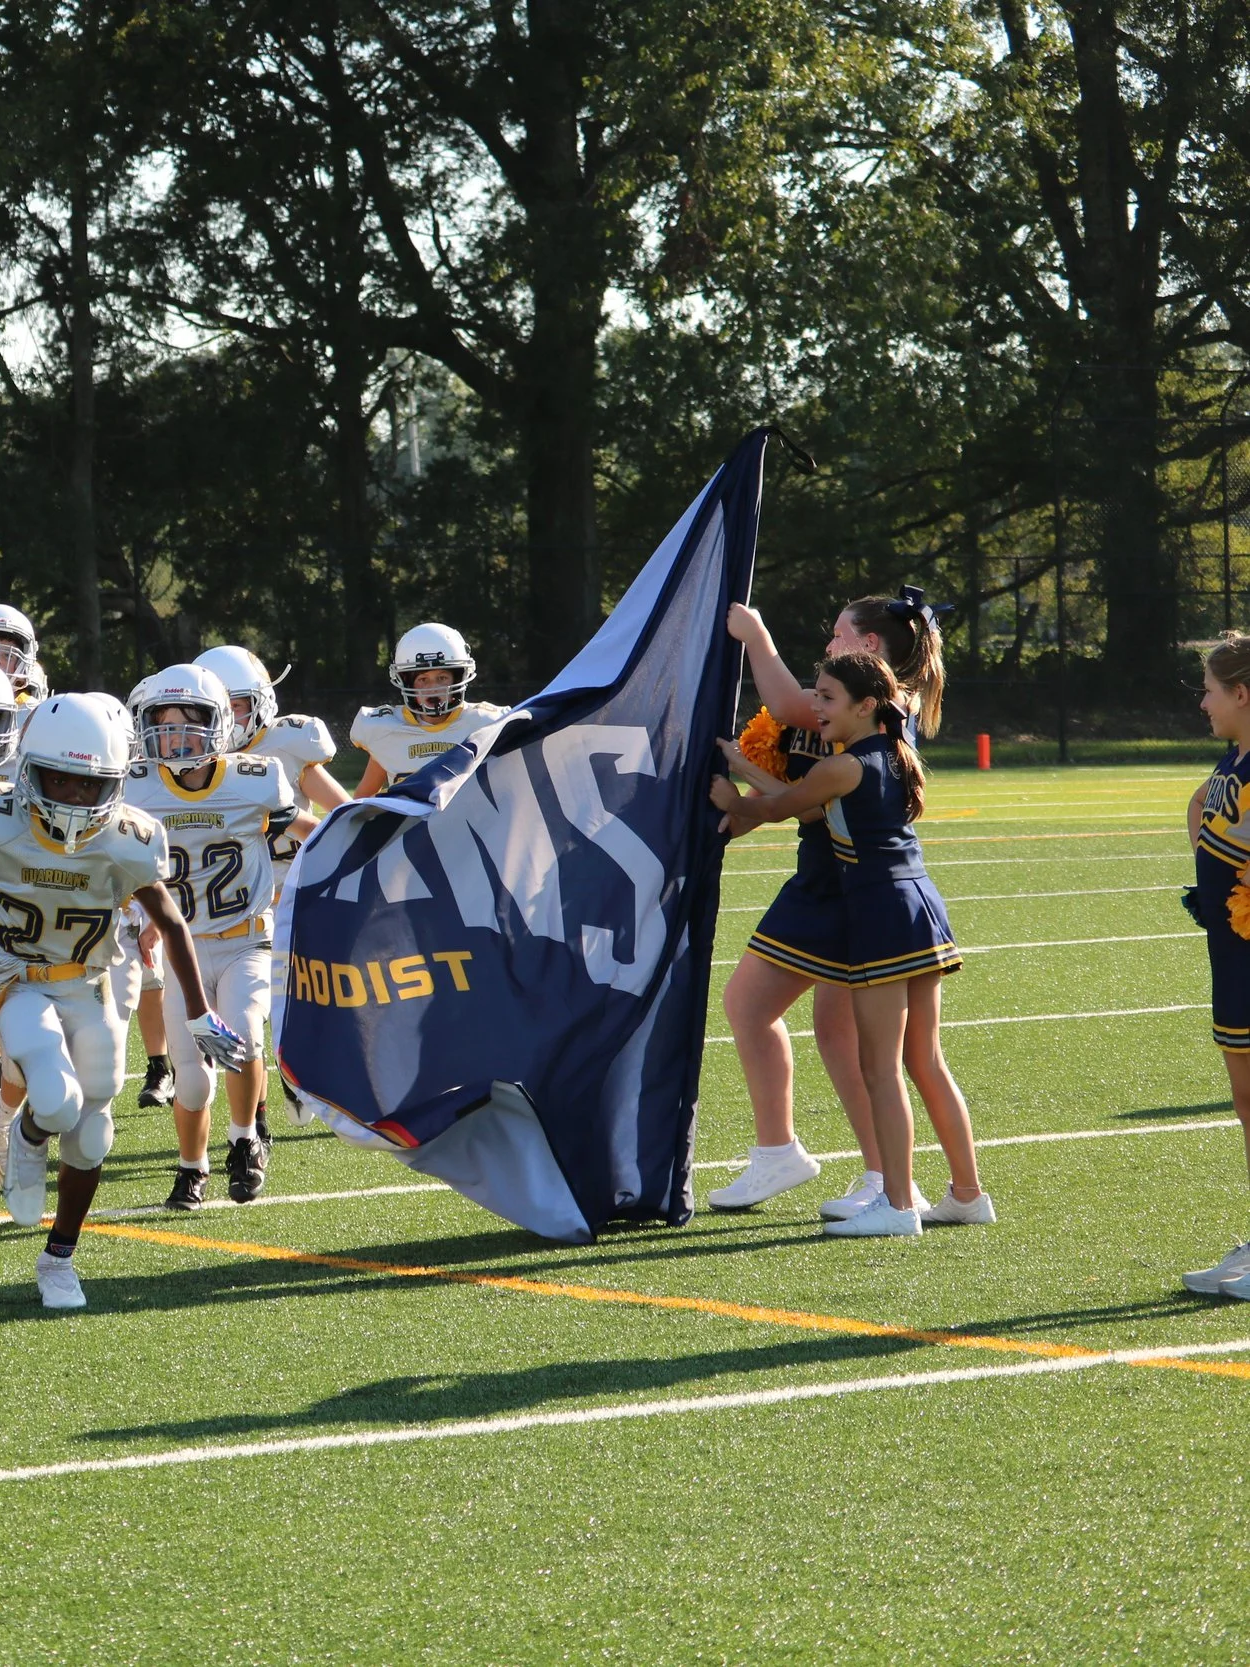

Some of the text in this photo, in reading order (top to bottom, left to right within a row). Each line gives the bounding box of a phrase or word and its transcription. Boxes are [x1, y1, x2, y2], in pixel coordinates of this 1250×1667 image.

[68, 751, 93, 761] Riddell
[162, 812, 225, 831] GUARDIANS
[21, 867, 91, 891] GUARDIANS
[290, 951, 473, 1008] HODIST
